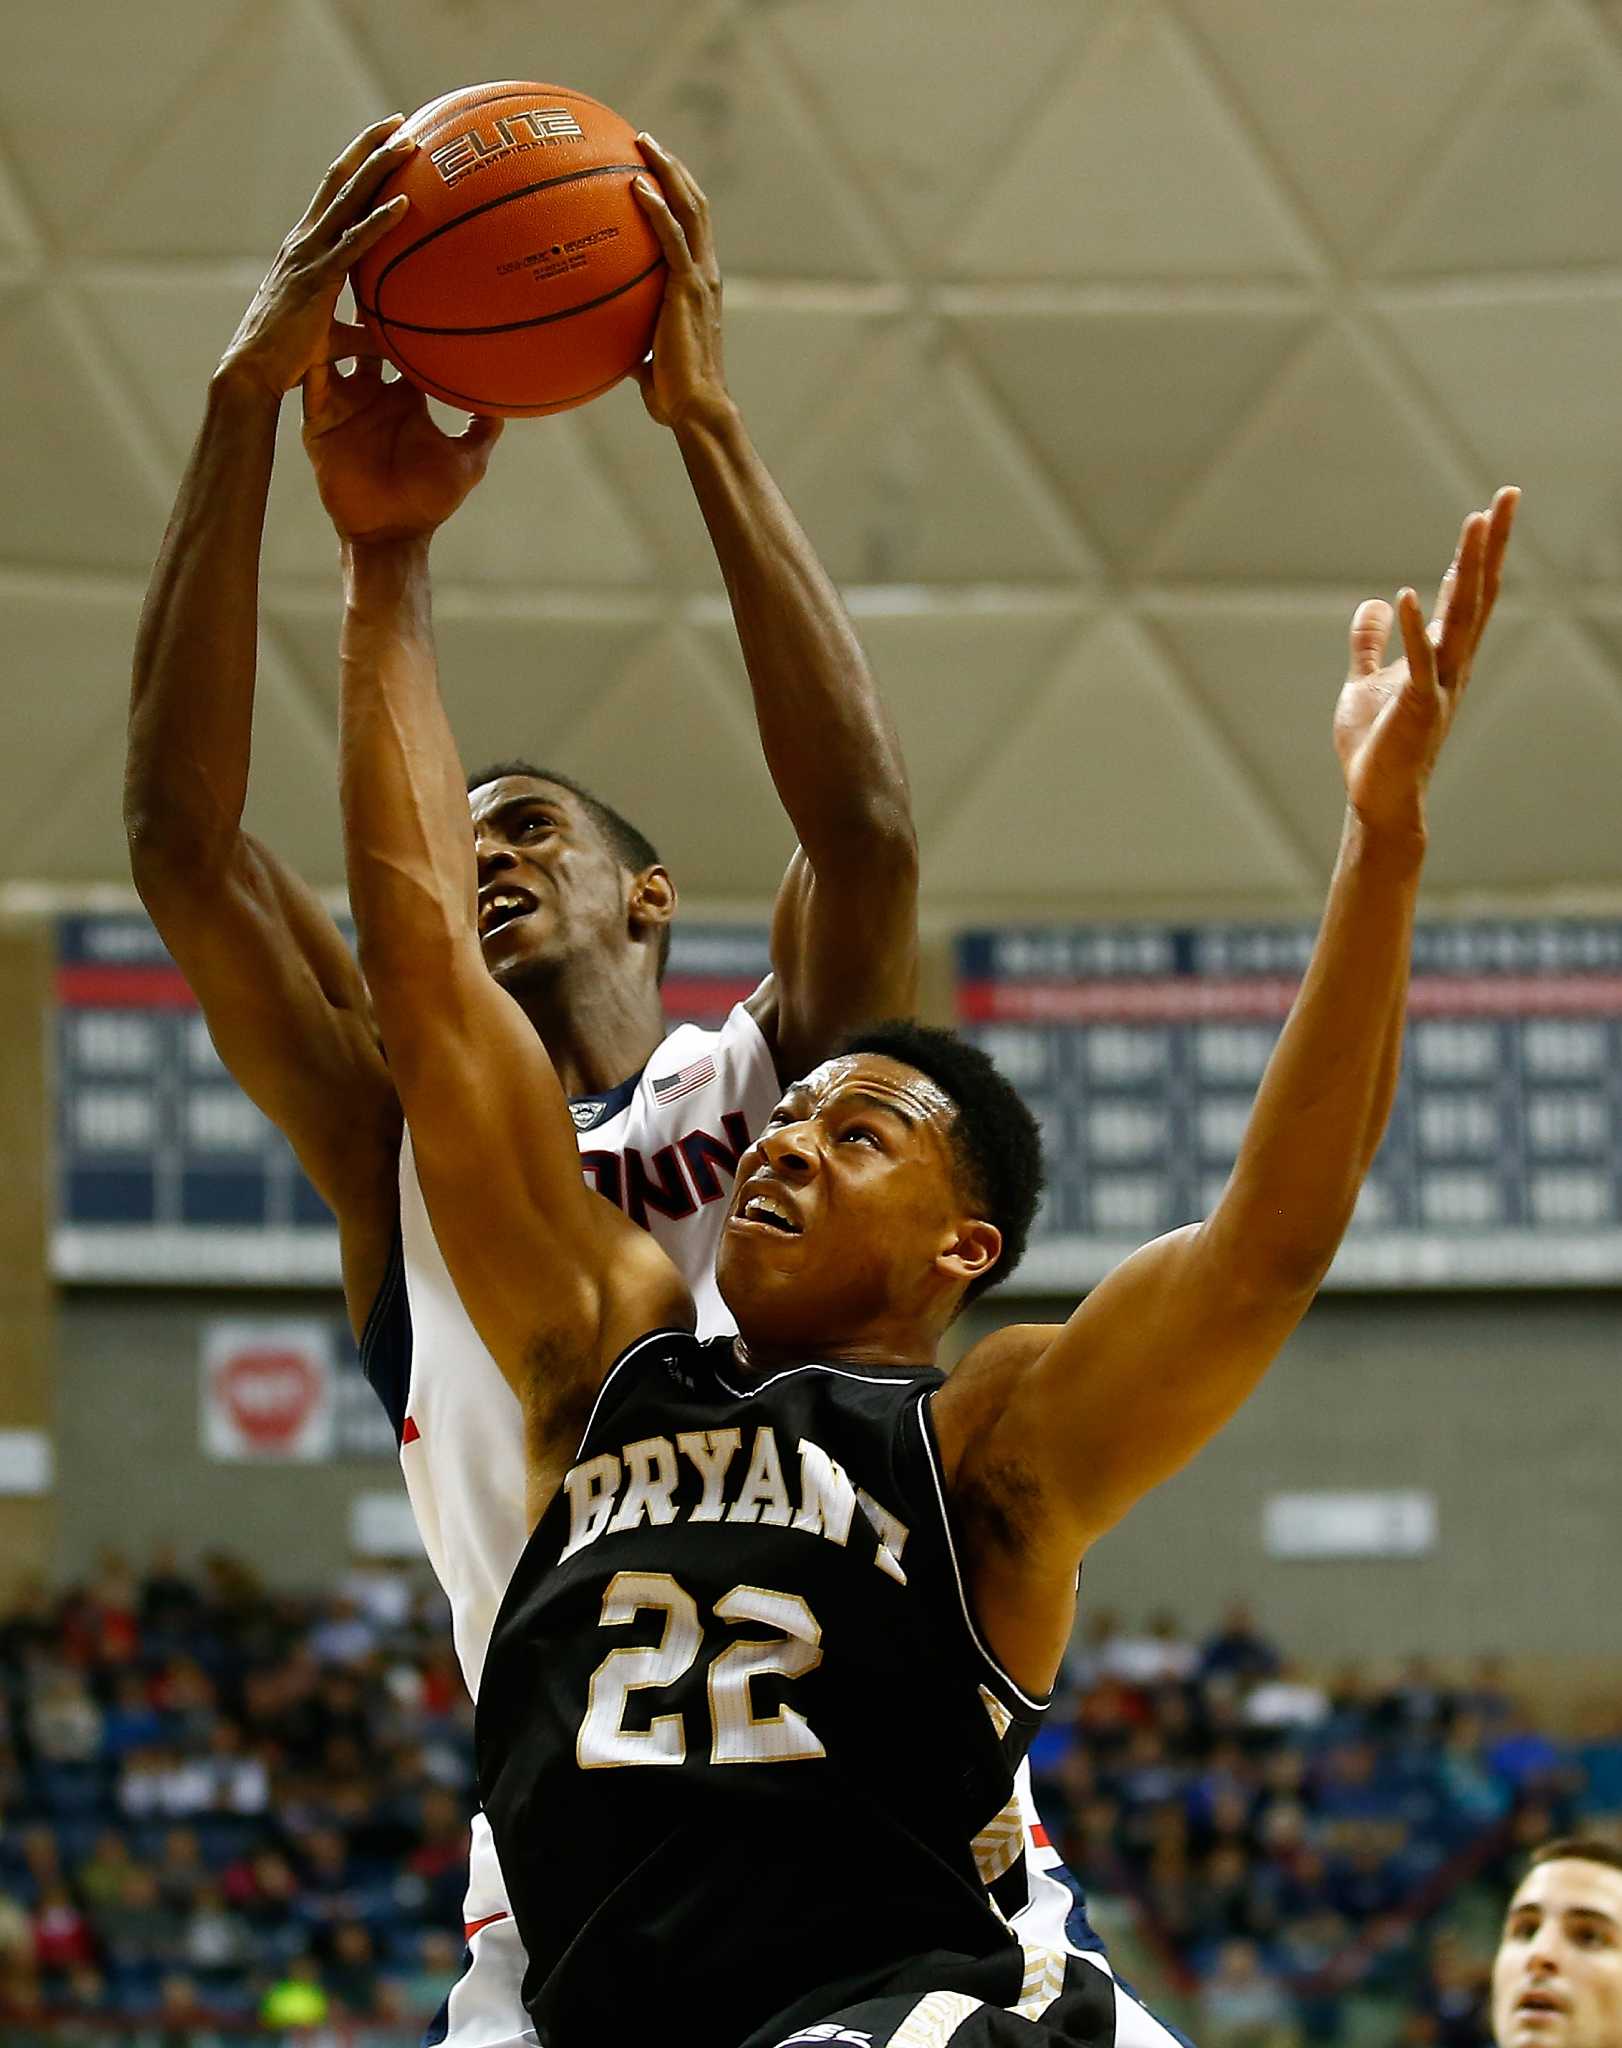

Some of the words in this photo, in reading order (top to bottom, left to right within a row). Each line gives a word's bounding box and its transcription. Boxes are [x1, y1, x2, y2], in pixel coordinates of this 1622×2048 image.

[430, 108, 582, 182] ELITE
[557, 1426, 909, 1586] BRYANT
[576, 1571, 826, 1769] 22
